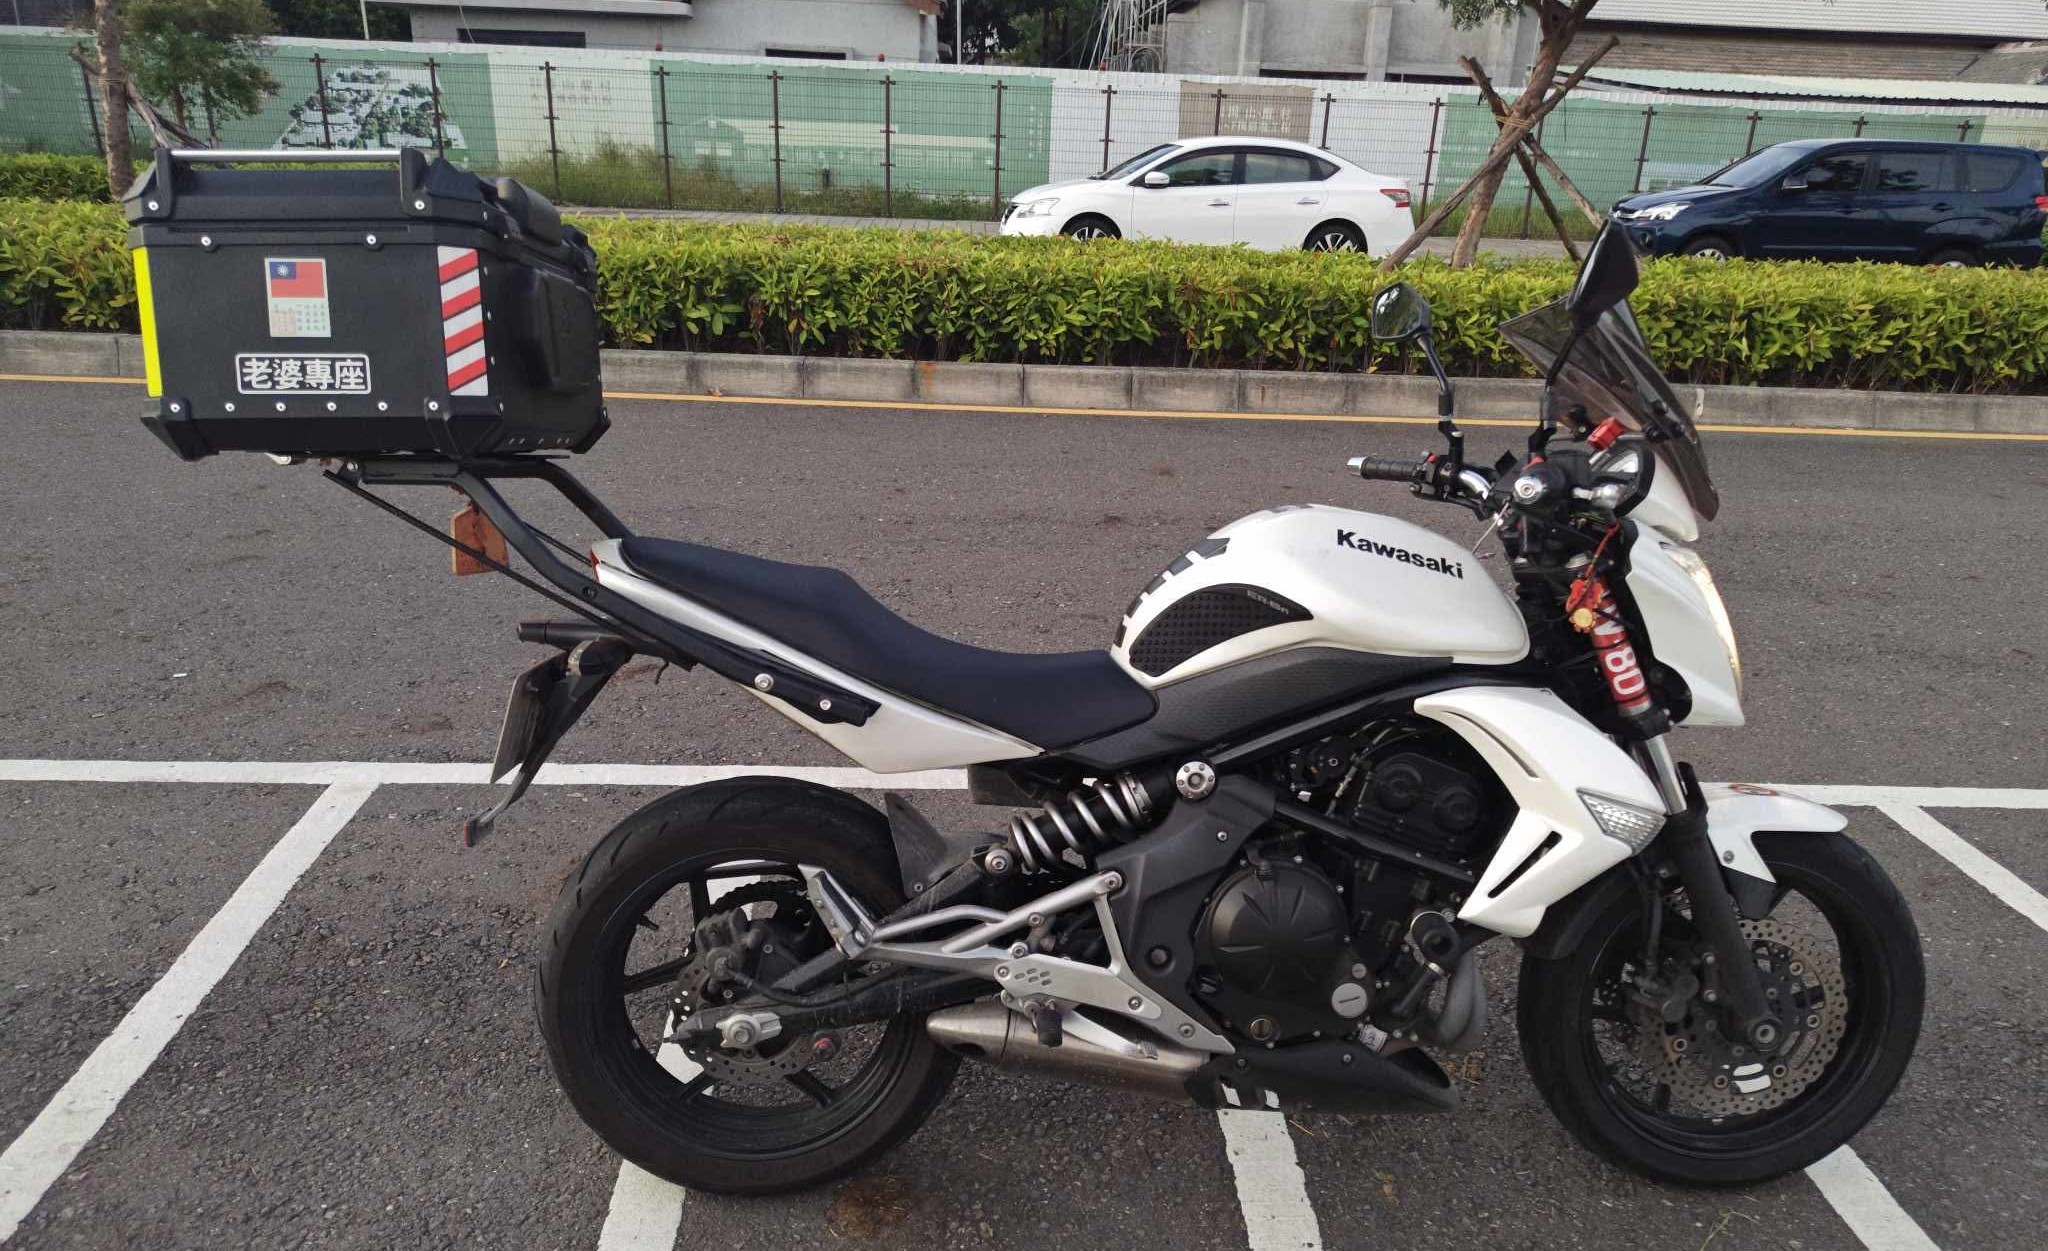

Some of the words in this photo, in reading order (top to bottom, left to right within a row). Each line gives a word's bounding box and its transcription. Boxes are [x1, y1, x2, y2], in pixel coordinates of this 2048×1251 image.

[242, 358, 366, 390] 老婆專座
[1337, 529, 1463, 579] Kawasaki
